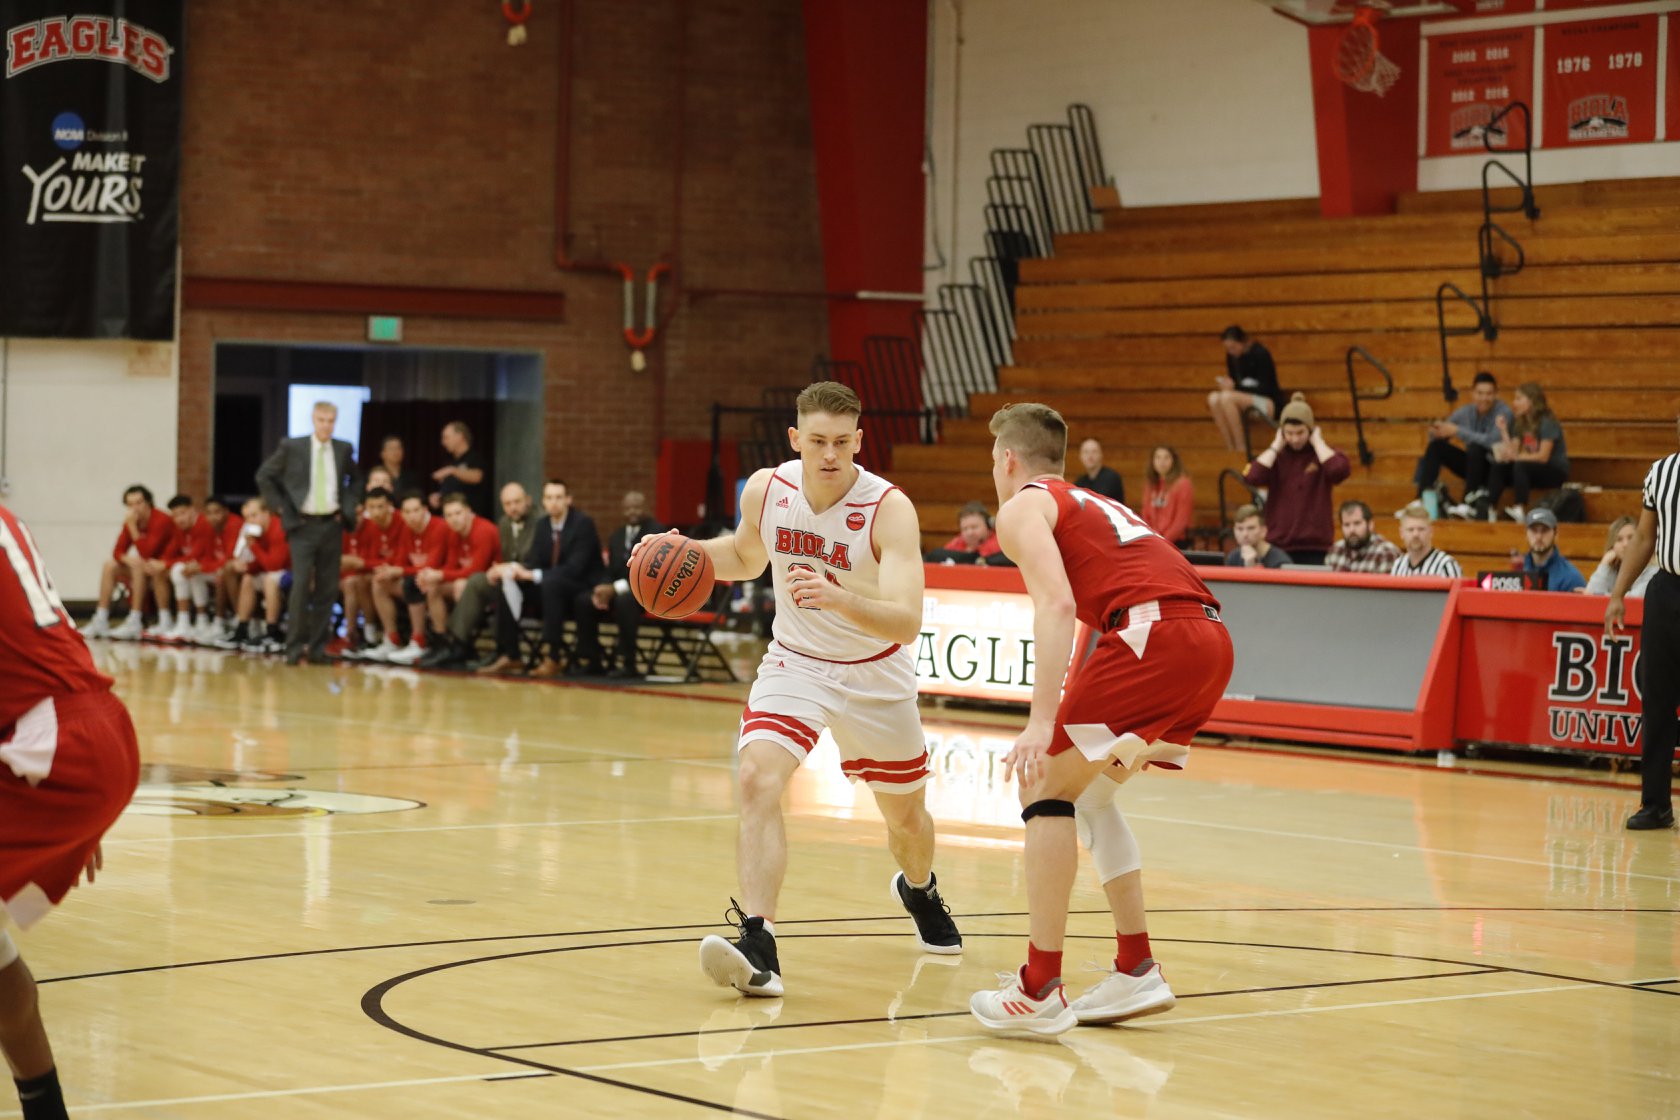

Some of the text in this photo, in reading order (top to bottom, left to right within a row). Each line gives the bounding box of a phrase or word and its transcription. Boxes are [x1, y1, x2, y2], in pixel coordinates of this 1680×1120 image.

[6, 15, 170, 83] EAGLES
[1557, 55, 1591, 74] 1976
[72, 152, 130, 172] MAKE
[21, 156, 145, 226] YOURS
[647, 541, 675, 579] NCAA
[775, 526, 851, 571] BIOLA
[664, 549, 701, 597] Wilson
[1548, 632, 1642, 706] BI
